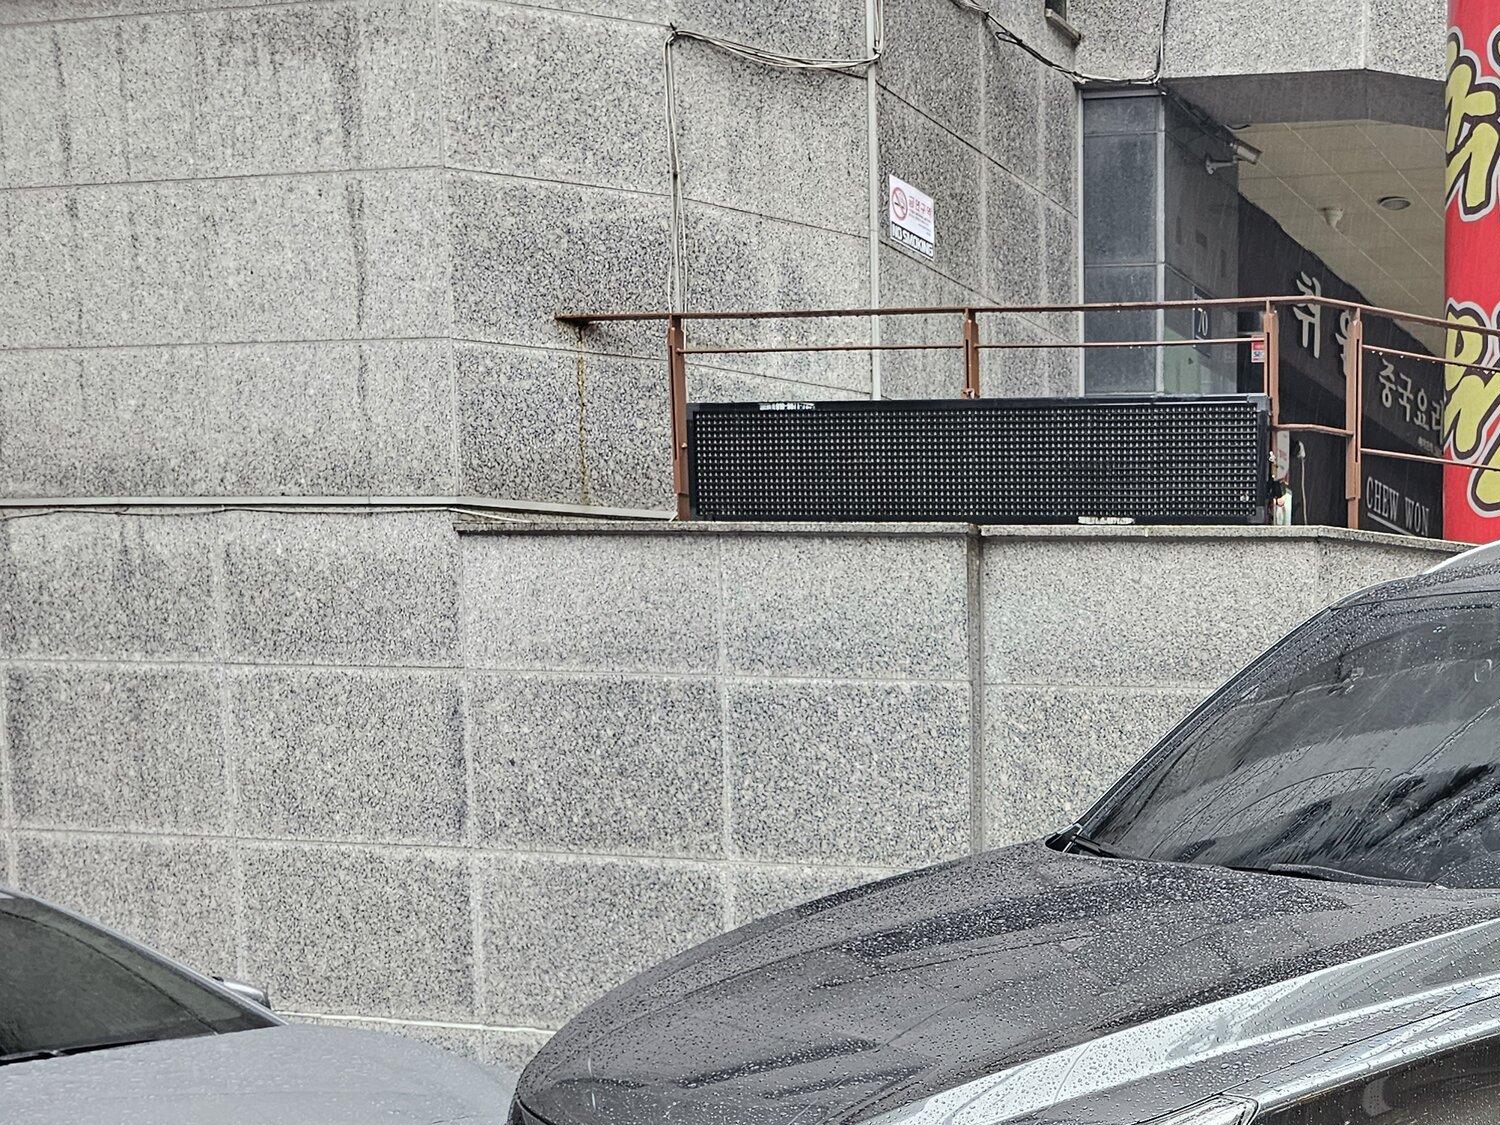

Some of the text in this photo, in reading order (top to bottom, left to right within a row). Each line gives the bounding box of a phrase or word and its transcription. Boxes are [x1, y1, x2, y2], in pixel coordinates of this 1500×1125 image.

[892, 222, 904, 241] NO
[902, 229, 934, 257] SMOKING
[1366, 476, 1430, 537] CHEW WON
